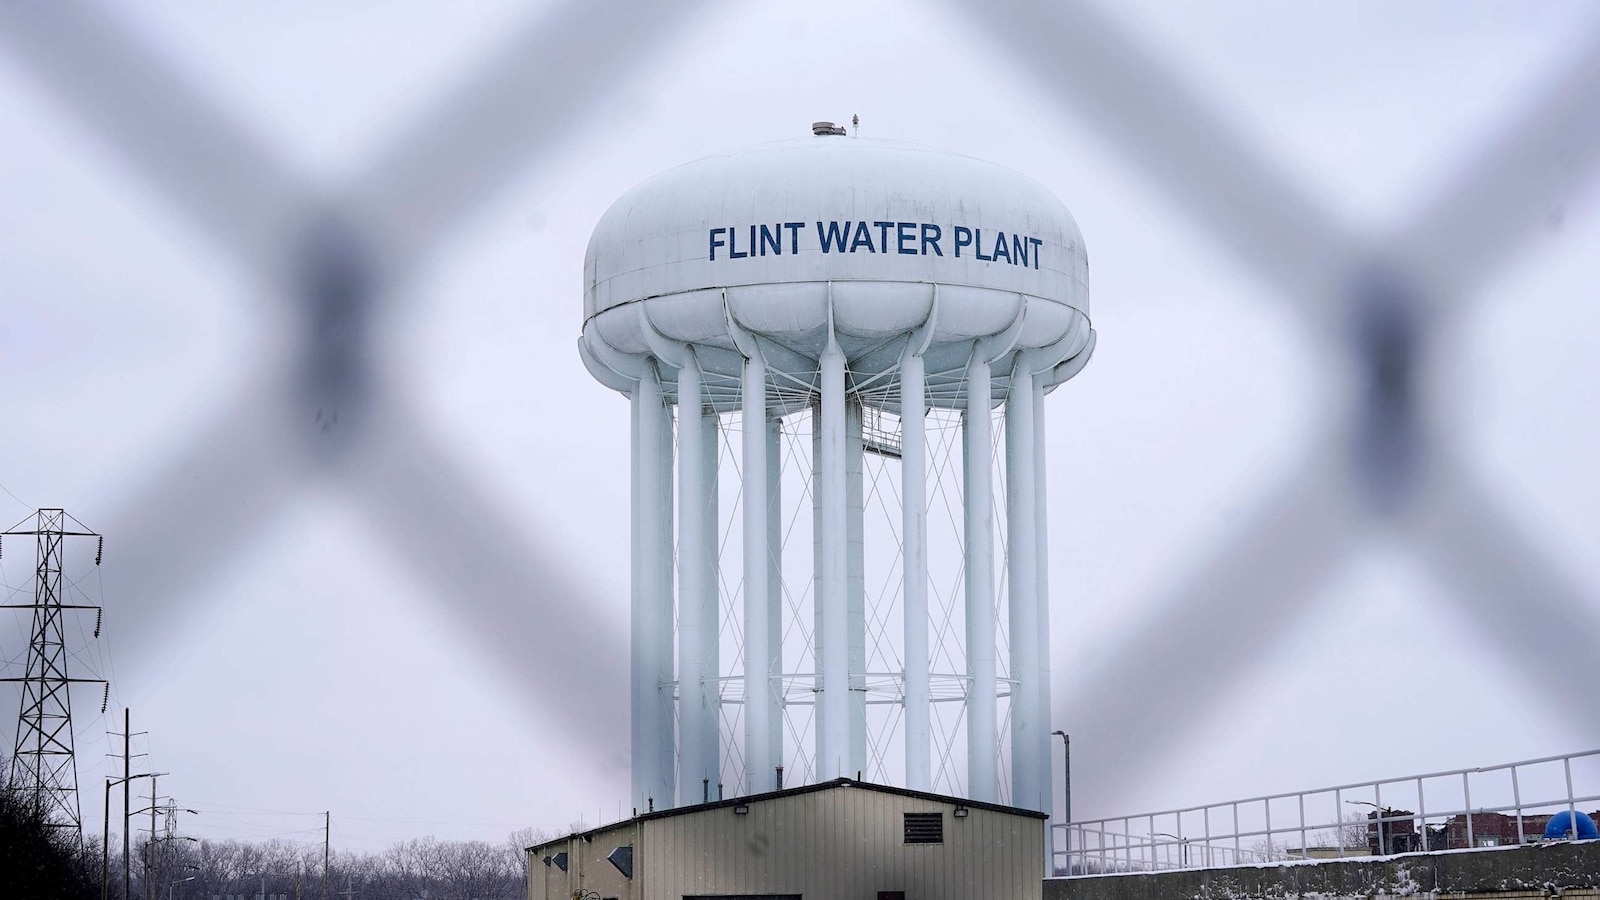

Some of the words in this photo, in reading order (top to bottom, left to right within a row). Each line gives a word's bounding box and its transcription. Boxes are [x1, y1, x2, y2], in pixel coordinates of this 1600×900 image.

[709, 221, 806, 262] FLINT
[816, 220, 944, 257] WATER
[954, 225, 1043, 271] PLANT
